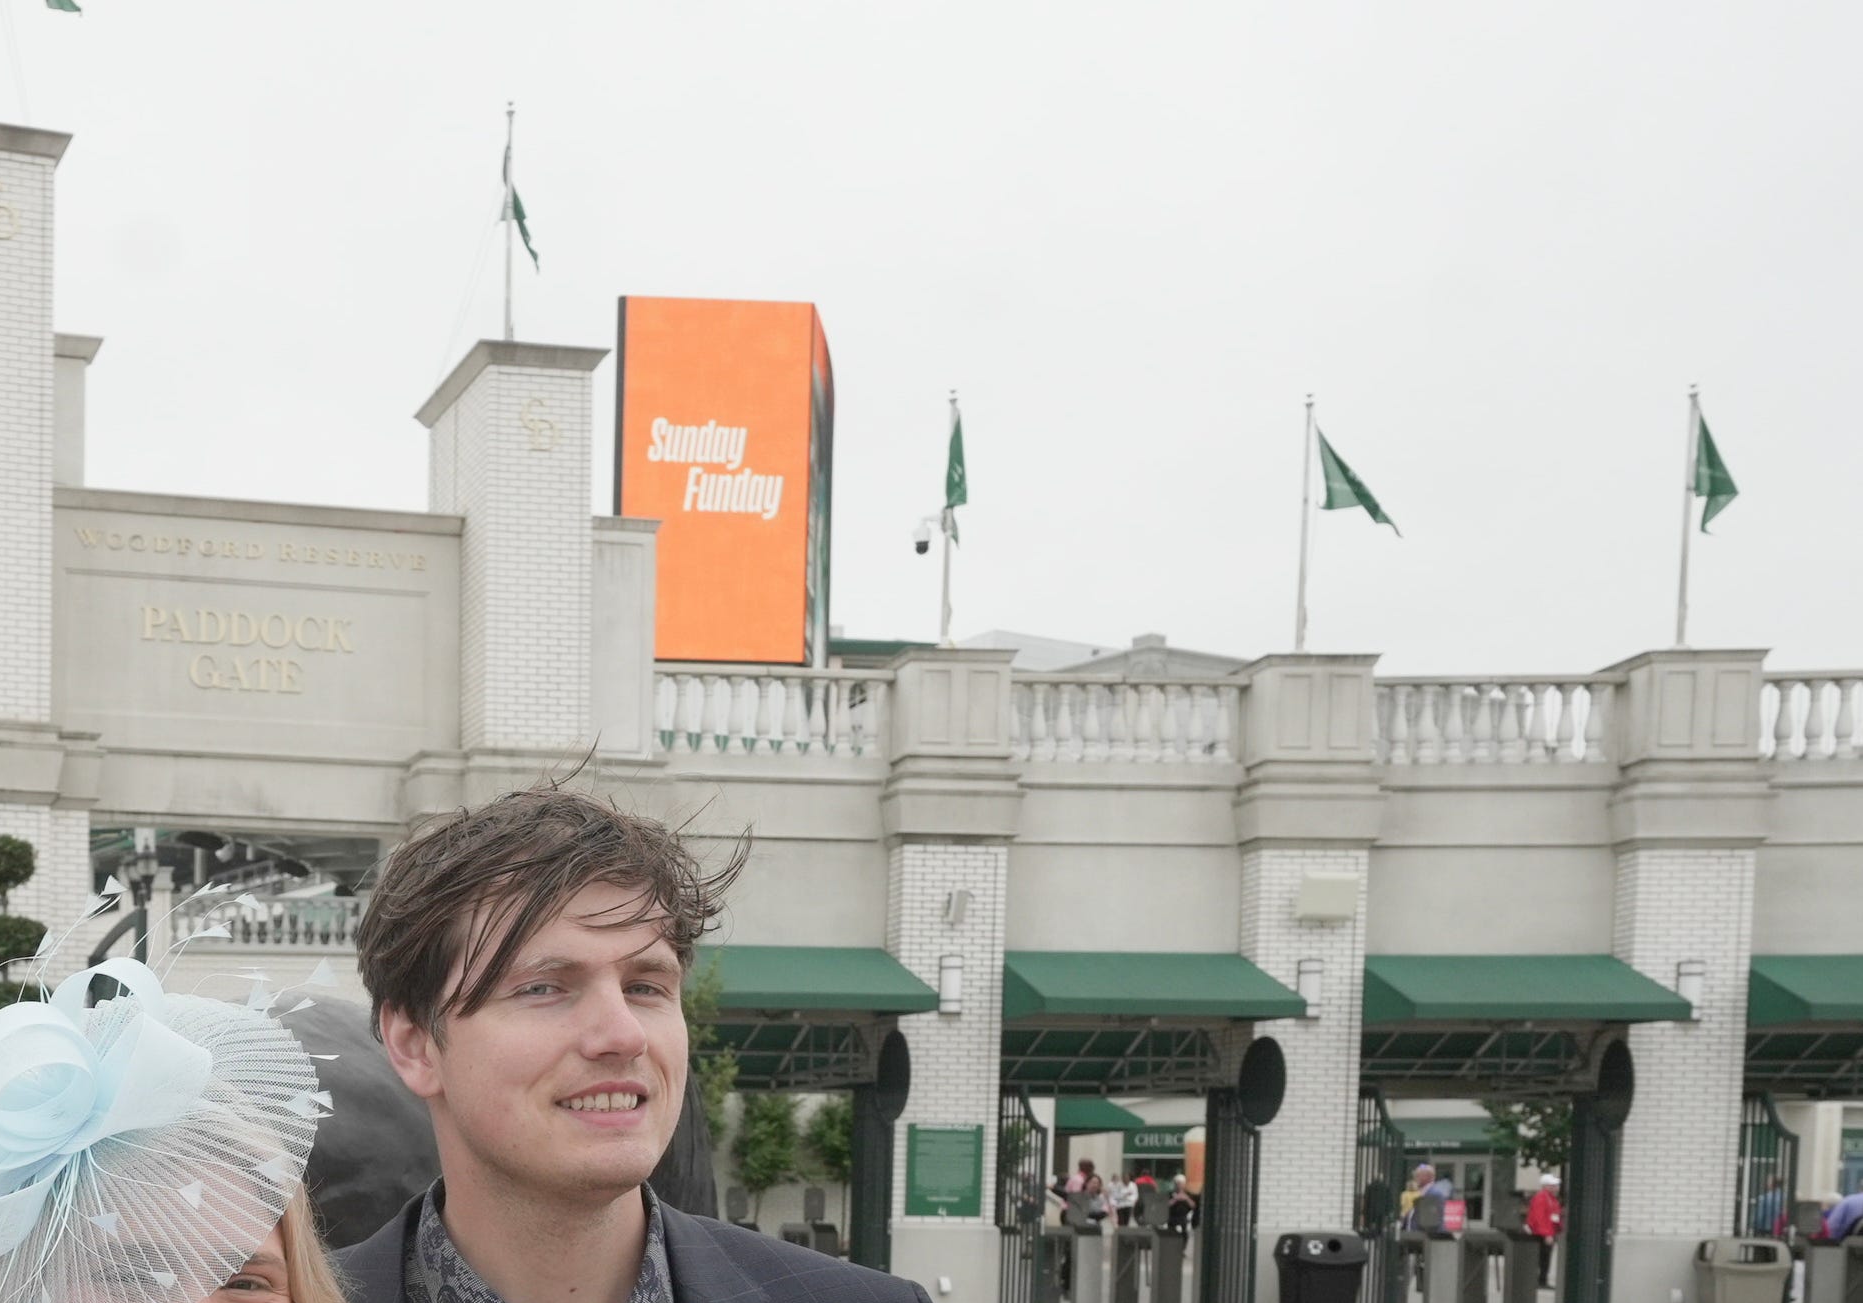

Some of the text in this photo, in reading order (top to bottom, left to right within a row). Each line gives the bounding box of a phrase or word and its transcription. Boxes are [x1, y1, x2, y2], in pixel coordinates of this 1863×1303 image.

[647, 416, 748, 470] Sunday
[683, 466, 784, 520] Funday
[74, 527, 427, 571] WOODFORD RESERVE
[140, 605, 355, 653] PADDOCK
[189, 654, 304, 694] GATE
